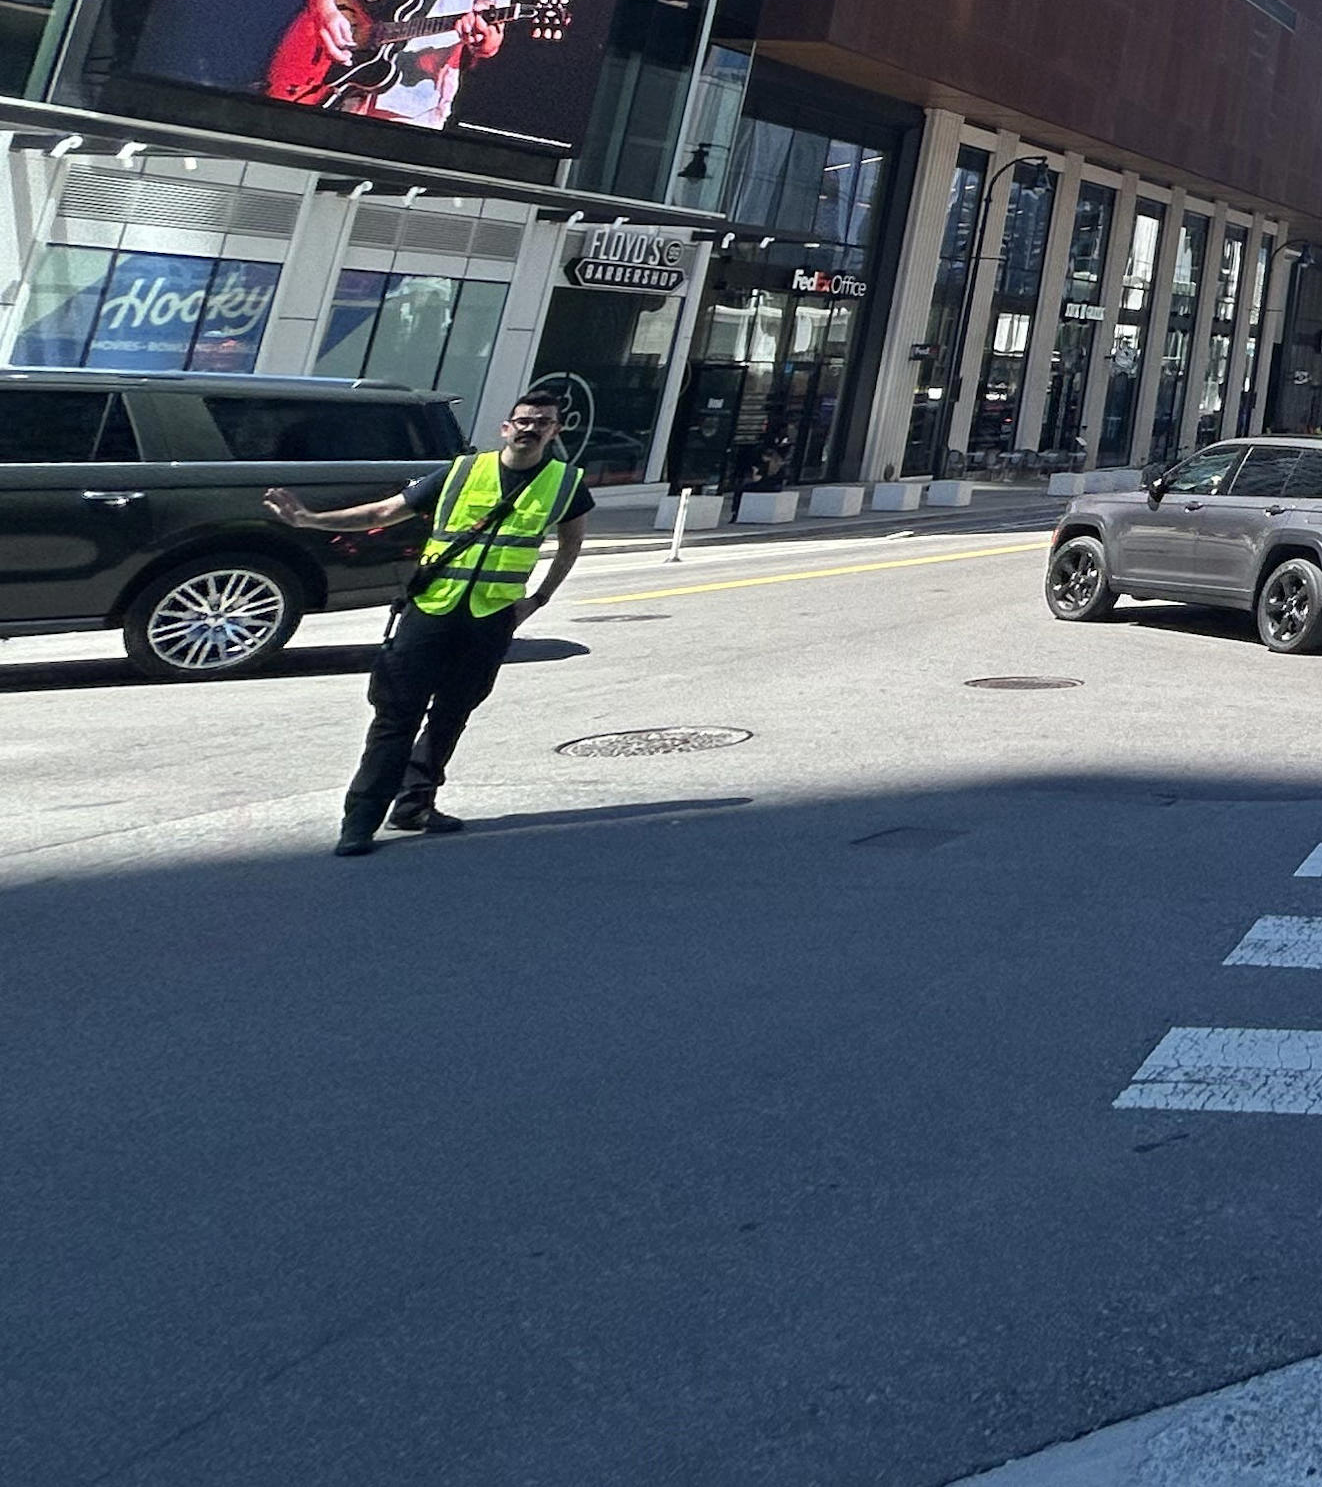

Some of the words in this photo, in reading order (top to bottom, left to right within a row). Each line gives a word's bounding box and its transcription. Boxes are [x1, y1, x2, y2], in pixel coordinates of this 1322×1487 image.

[589, 228, 665, 266] FLOYD'S
[583, 264, 678, 287] BARBERSHOP
[793, 268, 832, 293] FedEx
[831, 274, 868, 298] Office
[101, 271, 275, 338] Hooky
